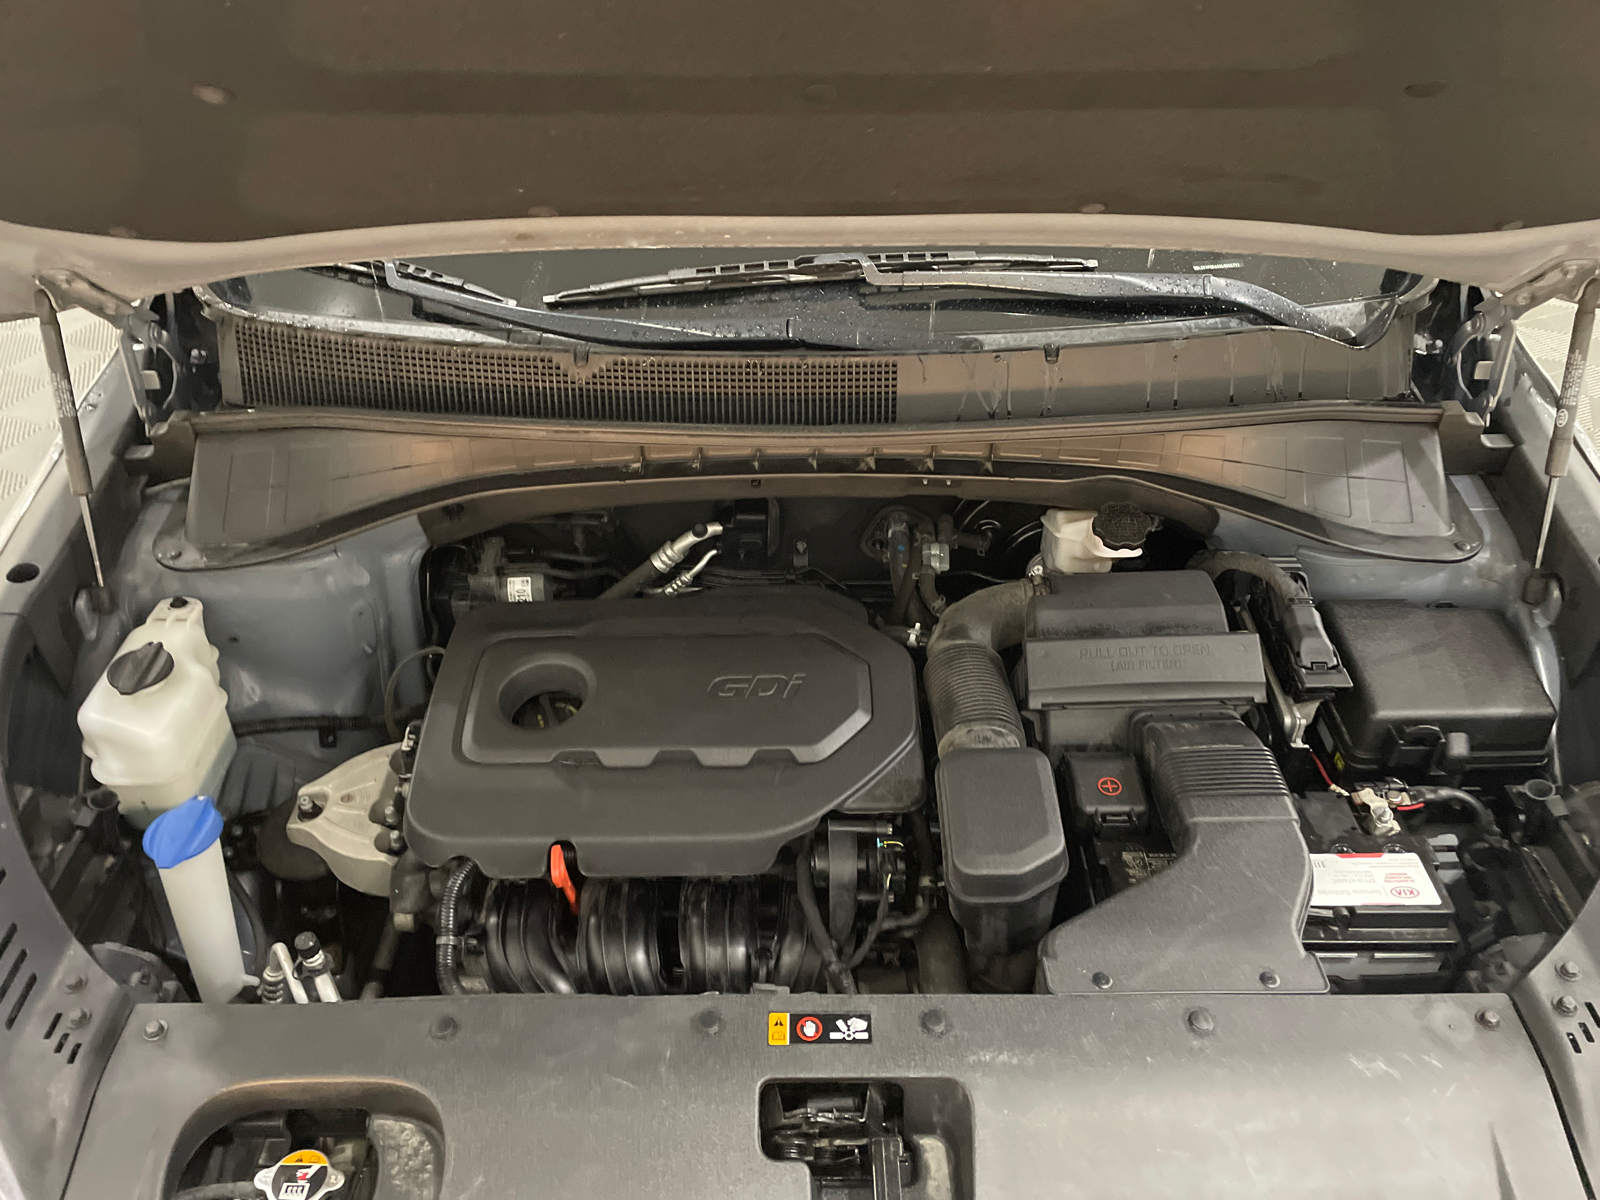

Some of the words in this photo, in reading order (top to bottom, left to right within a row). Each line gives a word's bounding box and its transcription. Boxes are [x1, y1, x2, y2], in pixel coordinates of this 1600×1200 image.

[1079, 647, 1115, 660] PULL
[1118, 646, 1146, 658] OUT
[1149, 645, 1169, 657] TO
[1172, 643, 1211, 656] OPEN
[1393, 888, 1416, 896] KIA
